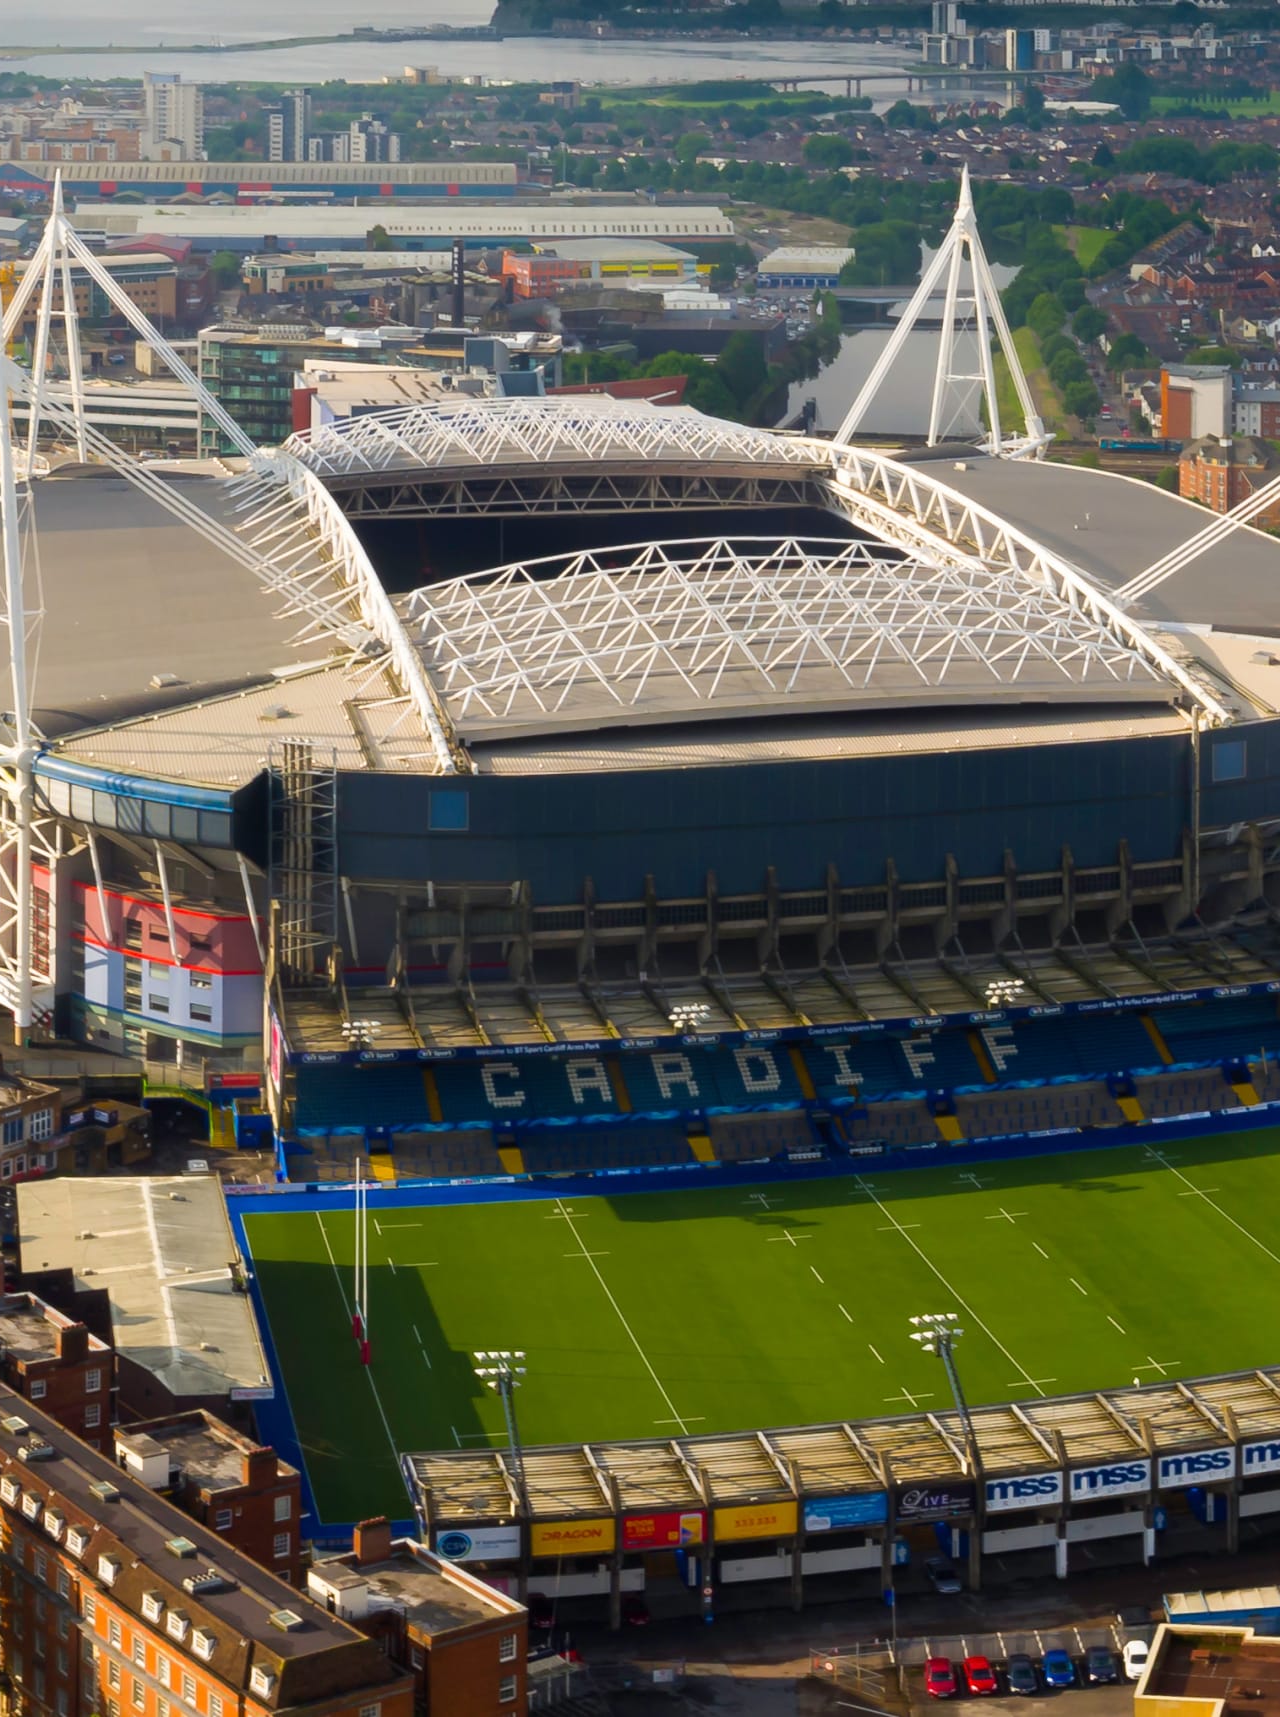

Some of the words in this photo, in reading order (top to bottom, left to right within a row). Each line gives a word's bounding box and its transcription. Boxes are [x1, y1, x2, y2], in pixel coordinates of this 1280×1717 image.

[515, 1046, 524, 1054] BT
[524, 1045, 543, 1054] Sport
[544, 1044, 566, 1052] Cardiff
[567, 1043, 584, 1051] Arms
[585, 1042, 600, 1050] Park
[481, 1024, 1019, 1109] CARDIFF
[1074, 1463, 1147, 1490] mss
[1161, 1451, 1231, 1477] mss
[986, 1476, 1058, 1500] mss
[541, 1529, 602, 1542] DRAGON
